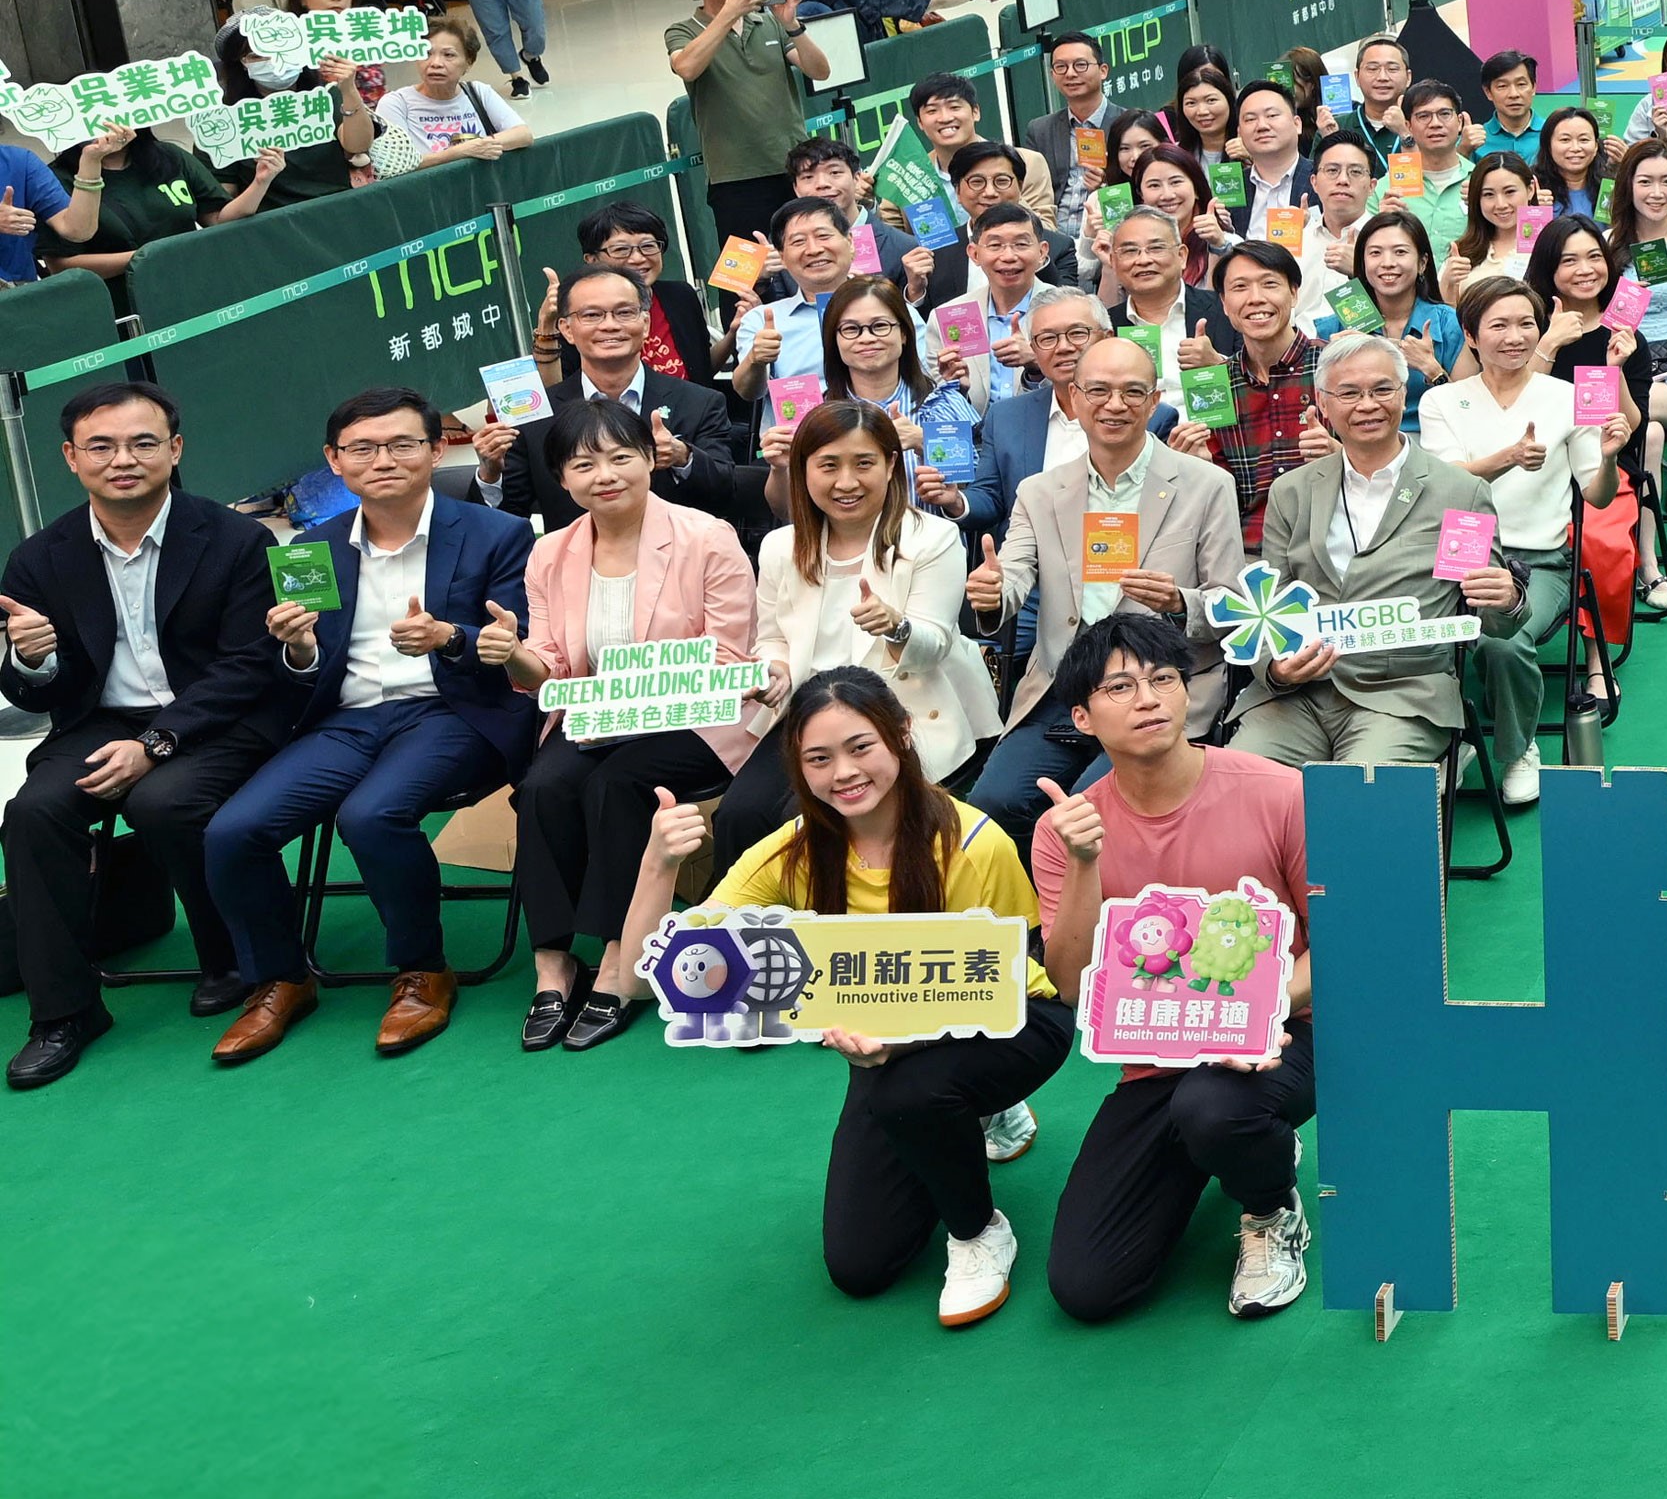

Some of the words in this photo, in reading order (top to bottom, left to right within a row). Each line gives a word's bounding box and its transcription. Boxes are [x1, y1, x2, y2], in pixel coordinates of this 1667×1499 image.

[305, 9, 428, 44] 吳業坤
[310, 40, 427, 67] KwanGor
[72, 56, 215, 113] 吳業坤
[1102, 66, 1165, 98] 新都城中心
[83, 87, 222, 138] KwanGor
[238, 90, 333, 134] 吳業坤
[446, 114, 461, 122] THE
[240, 123, 334, 158] KwanGor
[158, 180, 194, 207] 10
[388, 303, 501, 362] 新都城中
[1316, 603, 1416, 633] HKGBC
[1320, 620, 1476, 650] 香港綠色建築議會
[602, 644, 654, 672] HONG
[659, 639, 712, 665] KONG
[544, 680, 605, 707] GREEN
[610, 669, 704, 700] BUILDING
[709, 664, 765, 691] WEEK
[568, 698, 737, 736] 香港綠色建築週
[829, 948, 1002, 987] 創新元素
[836, 989, 919, 1005] Innovative
[922, 988, 995, 1003] Elements
[1115, 997, 1250, 1030] 健康舒適
[1113, 1029, 1152, 1042] Health
[1155, 1030, 1179, 1043] and
[1182, 1031, 1246, 1046] Well-being
